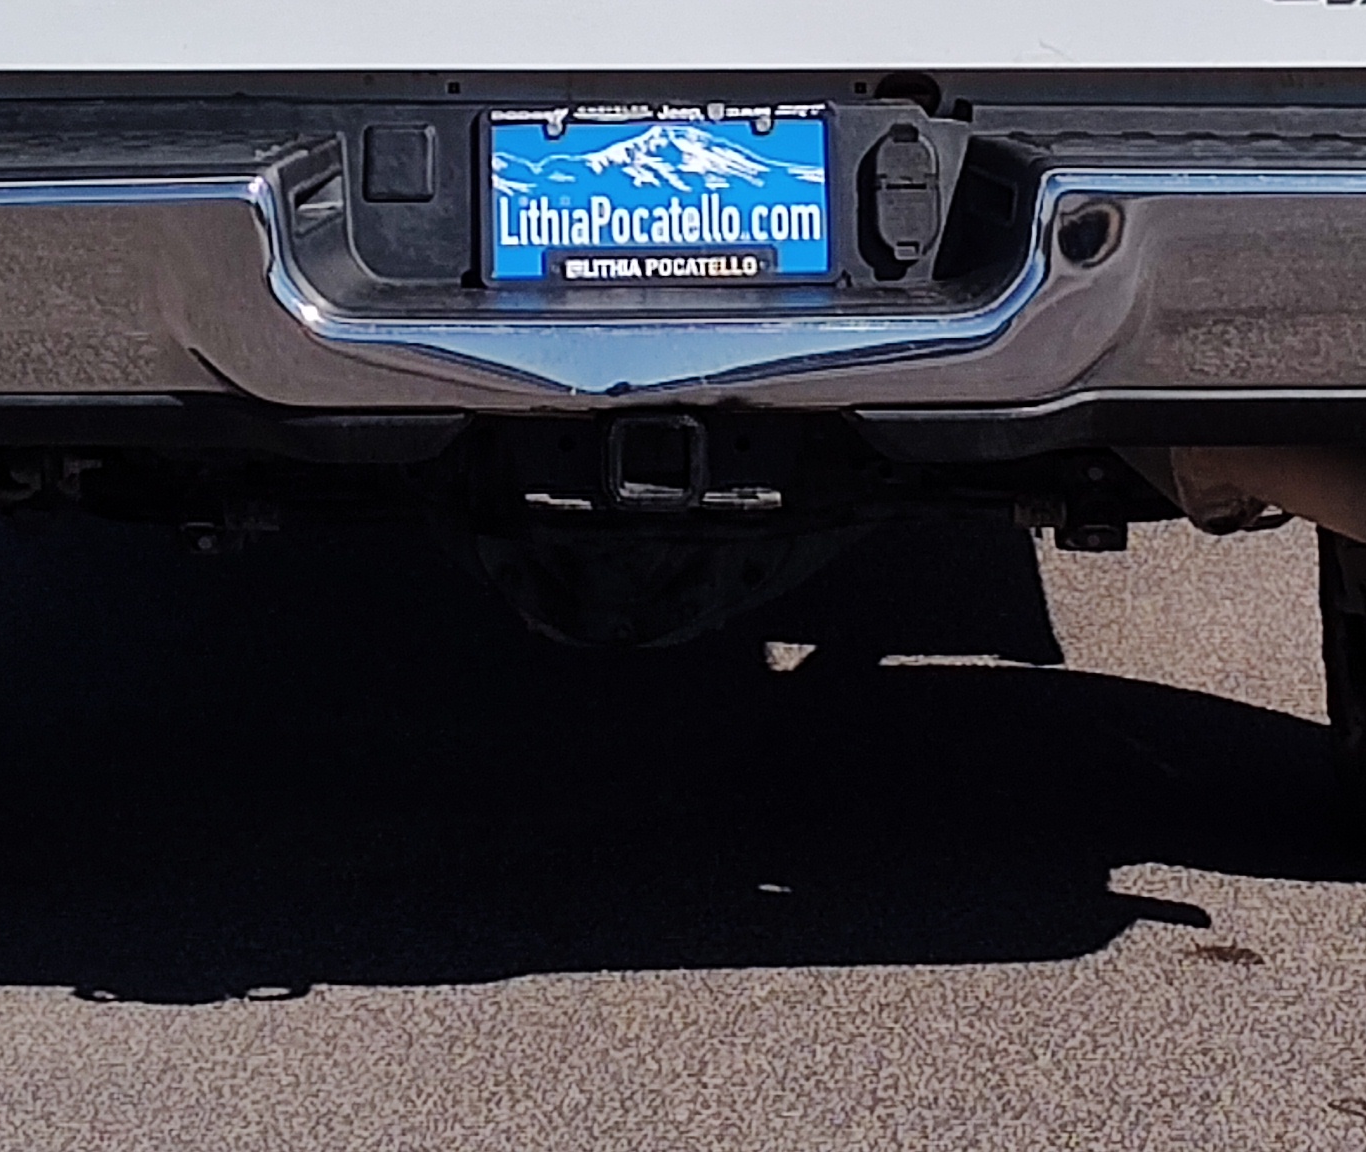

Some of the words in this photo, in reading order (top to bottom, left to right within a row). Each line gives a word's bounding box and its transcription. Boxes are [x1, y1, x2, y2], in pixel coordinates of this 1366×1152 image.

[500, 193, 821, 246] LithiaPocatello.com
[584, 257, 642, 278] LITHIA
[645, 256, 758, 277] POCATELLO
